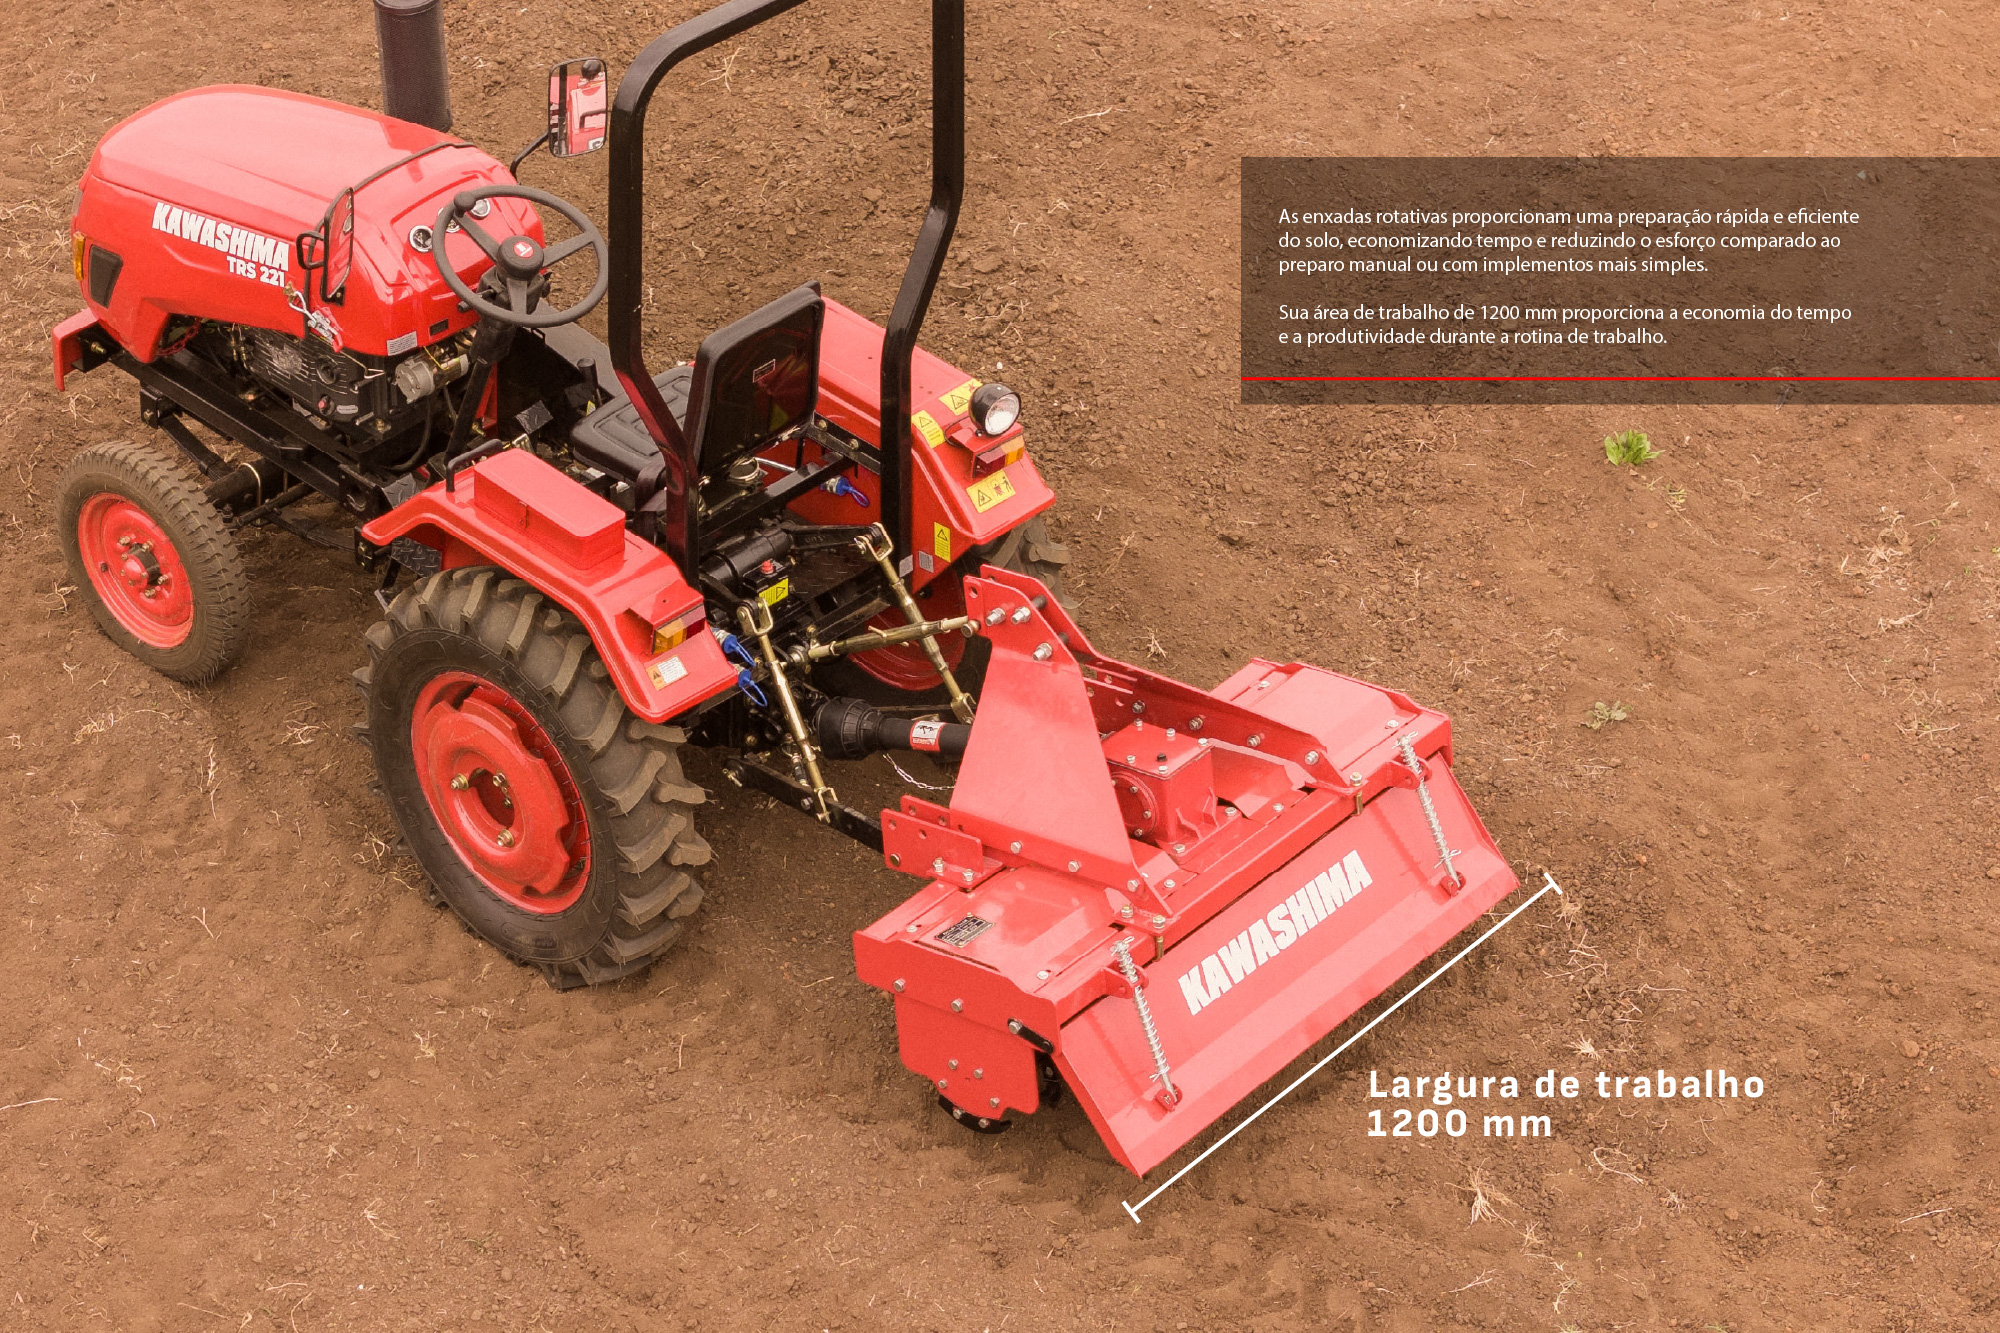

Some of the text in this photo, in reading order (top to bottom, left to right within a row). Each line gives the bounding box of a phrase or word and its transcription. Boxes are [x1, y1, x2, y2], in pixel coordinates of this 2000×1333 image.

[152, 202, 289, 272] KAWASHIMA
[227, 256, 285, 287] TRS 221
[1178, 850, 1373, 1016] KAWASHIMA
